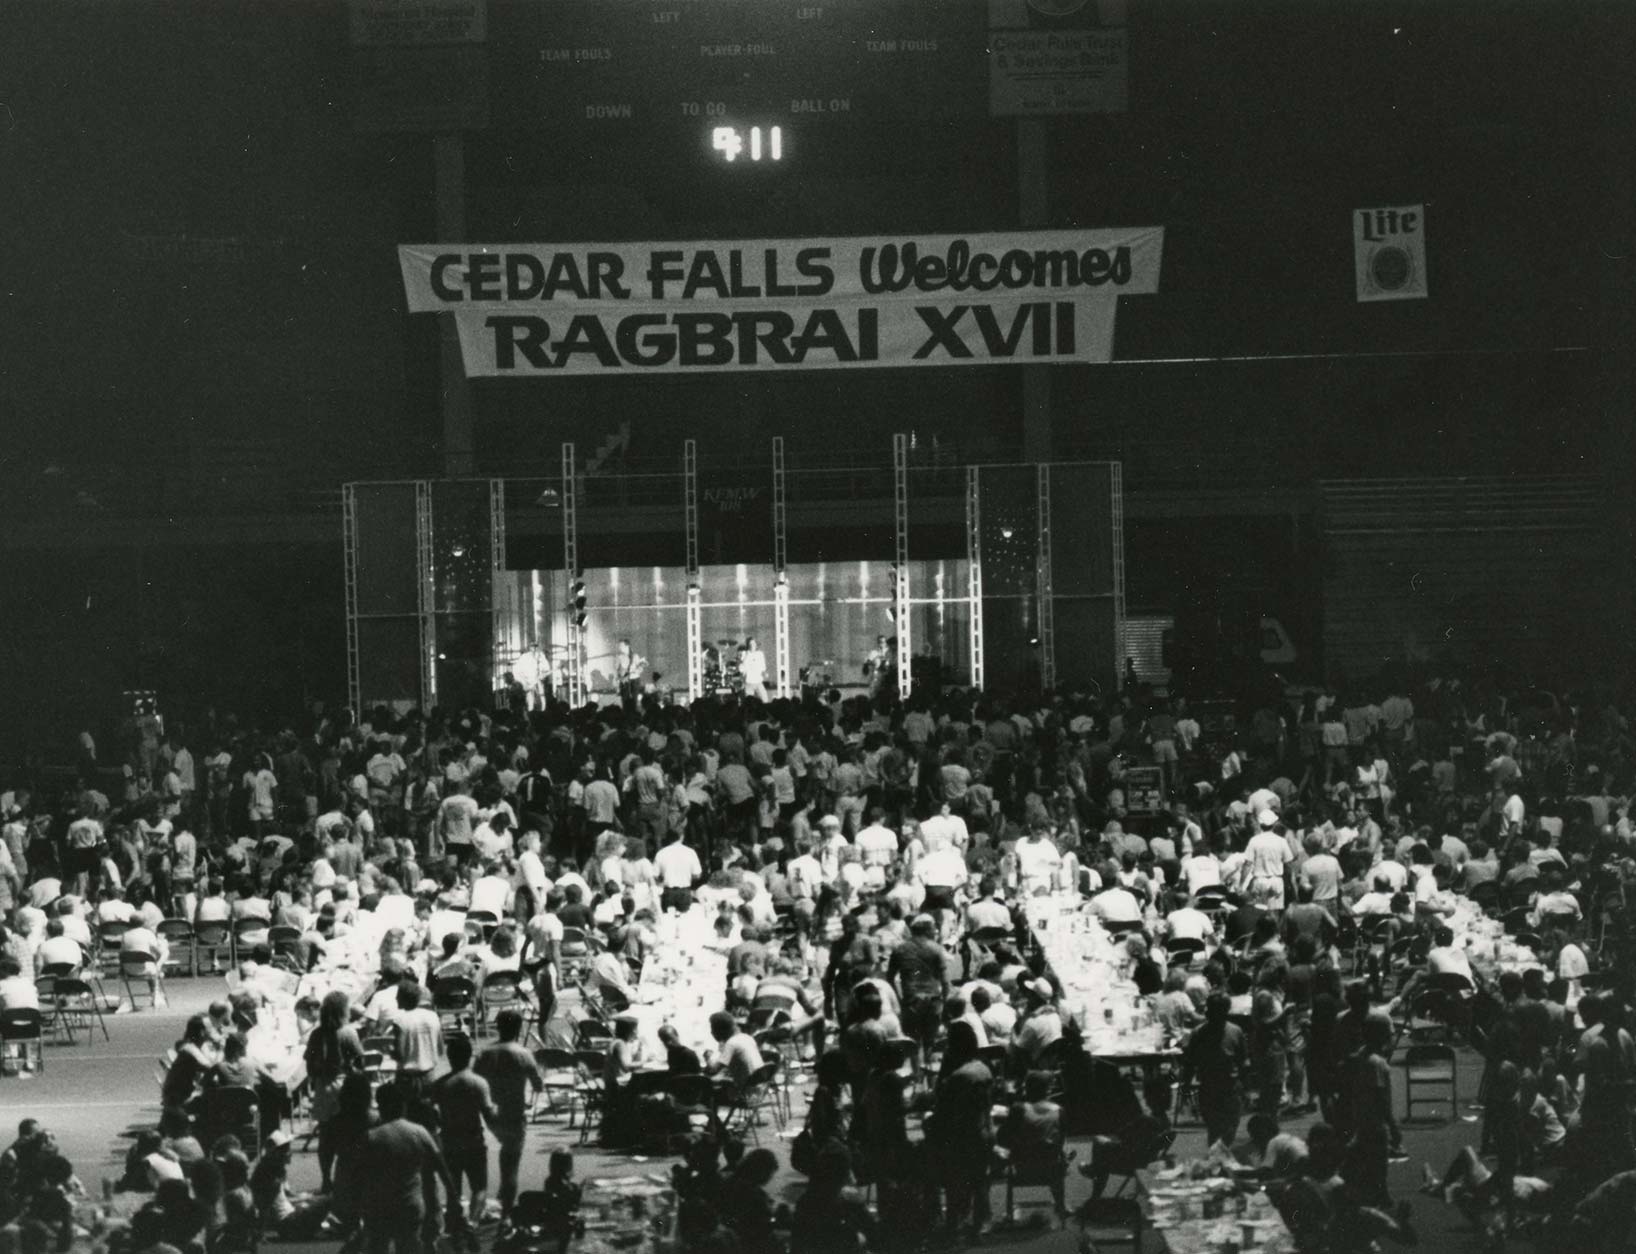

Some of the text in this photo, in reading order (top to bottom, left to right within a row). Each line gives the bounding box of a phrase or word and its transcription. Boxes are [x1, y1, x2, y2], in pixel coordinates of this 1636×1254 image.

[866, 39, 938, 52] TEAM FOULS
[540, 47, 612, 61] TEAM FOULS
[586, 105, 632, 119] DOWN
[680, 101, 727, 116] TO GO
[791, 98, 851, 113] BALL ON
[1360, 209, 1418, 242] Lite
[430, 238, 1132, 301] CEDAR FALLS Welcomes
[485, 301, 1075, 369] RAGBRAI XVII
